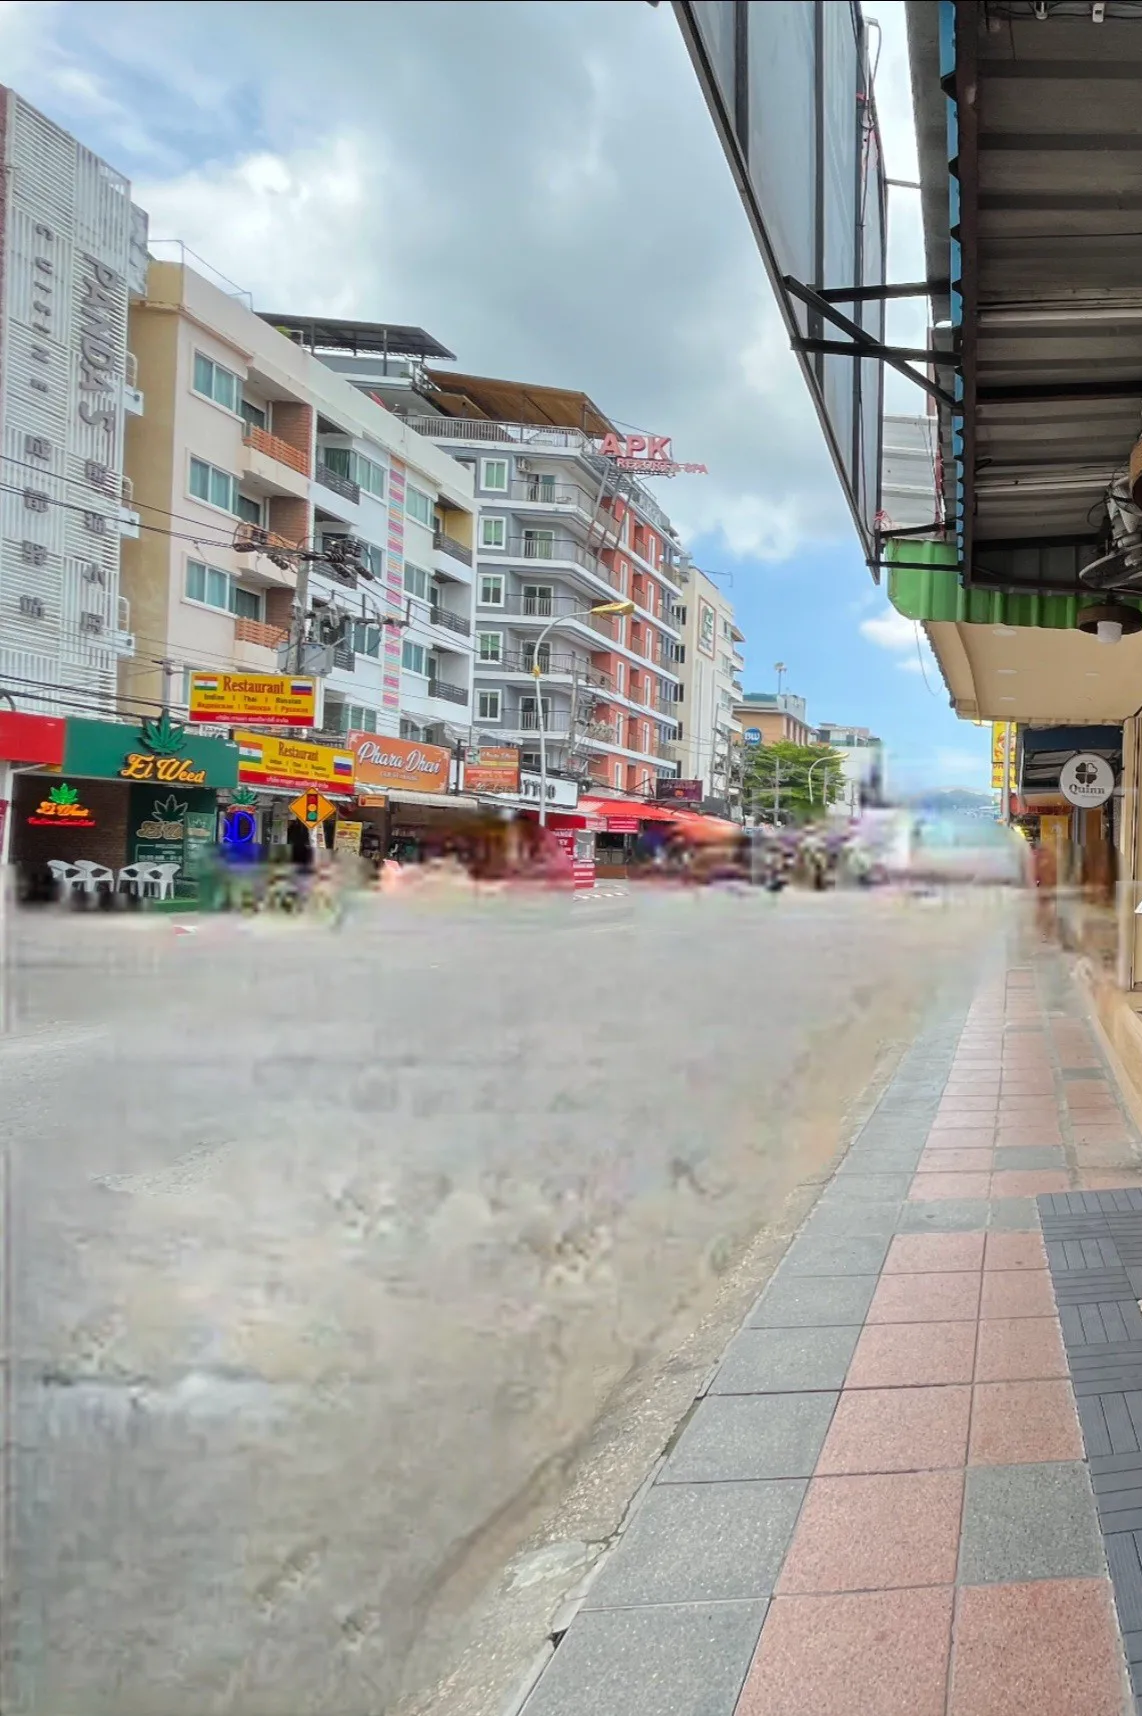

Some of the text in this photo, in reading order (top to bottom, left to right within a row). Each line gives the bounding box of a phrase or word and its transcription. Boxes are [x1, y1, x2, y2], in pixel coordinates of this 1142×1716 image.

[29, 223, 54, 392] CUISINE
[78, 253, 118, 433] PANDAS
[600, 432, 672, 461] APK
[222, 676, 285, 694] Restaurant
[278, 741, 319, 761] Restaurant
[358, 741, 403, 768] Phara
[120, 753, 205, 784] El Weed
[1069, 783, 1105, 795] Quinn
